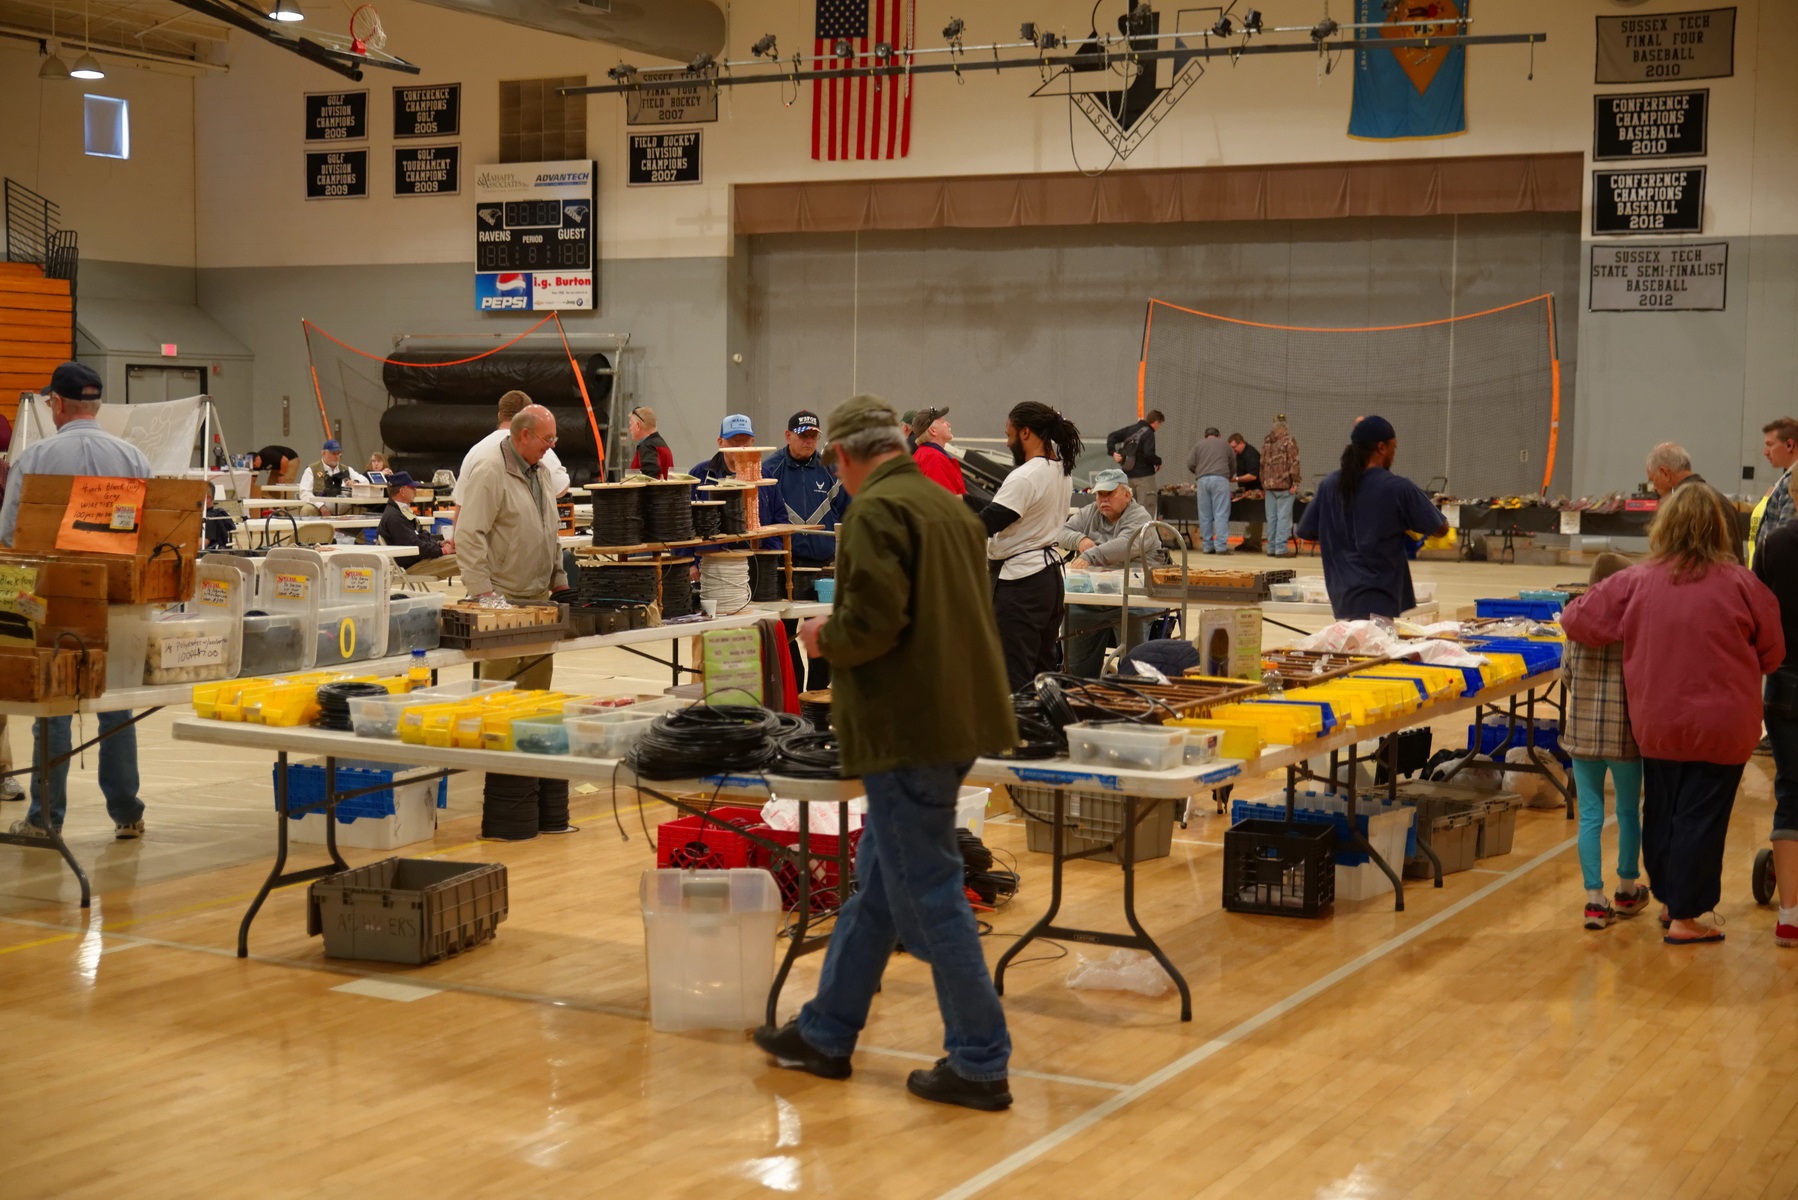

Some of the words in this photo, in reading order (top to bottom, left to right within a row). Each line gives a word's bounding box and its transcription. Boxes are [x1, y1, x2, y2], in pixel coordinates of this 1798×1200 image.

[1621, 18, 1668, 33] SUSSEX
[1679, 15, 1710, 28] TECH
[1625, 33, 1662, 48] FINAL
[1673, 31, 1704, 45] FOUR
[1633, 47, 1695, 63] BASEBALL
[1645, 63, 1681, 78] 2010
[327, 95, 346, 105] GOLF
[403, 88, 450, 101] CONFERENCE
[405, 100, 447, 112] CHAMPIONS
[642, 98, 664, 109] FIELD
[670, 95, 701, 108] HOCKEY
[1612, 95, 1690, 112] CONFERENCE
[321, 105, 352, 117] DIVISION
[416, 111, 436, 122] GOLF
[658, 109, 684, 120] 2007
[316, 116, 355, 128] CHAMPIONS
[1615, 110, 1685, 127] CHAMPIONS
[324, 127, 347, 139] 2005
[414, 122, 438, 133] 2005
[1618, 124, 1681, 141] BASEBALL
[634, 136, 657, 148] FIELD
[663, 134, 695, 147] HOCKEY
[1631, 140, 1667, 154] 2010
[327, 153, 346, 164] GOLF
[417, 149, 436, 160] GOLF
[646, 146, 683, 159] DIVISION
[321, 163, 352, 175] DIVISION
[402, 159, 451, 171] TOURNAMENT
[641, 158, 688, 171] CHAMPIONS
[316, 174, 356, 185] CHAMPIONS
[405, 170, 447, 182] CHAMPIONS
[535, 172, 590, 182] ADVANTECH
[651, 170, 677, 182] 2007
[1610, 172, 1687, 189] CONFERENCE
[325, 184, 348, 196] 2009
[414, 181, 439, 192] 2009
[1613, 186, 1683, 202] CHAMPIONS
[1616, 201, 1678, 216] BASEBALL
[1629, 215, 1664, 229] 2012
[478, 230, 511, 242] RAVENS
[522, 234, 543, 244] PERIOD
[557, 228, 586, 240] GUEST
[1614, 250, 1660, 263] SUSSEX
[1670, 249, 1702, 262] TECH
[1593, 264, 1629, 278] STATE
[1637, 262, 1725, 277] SEMI-FINALIST
[533, 276, 552, 289] i.g.
[555, 276, 591, 286] Burton
[1626, 278, 1688, 293] BASEBALL
[481, 296, 528, 309] PEPSI
[1639, 293, 1674, 307] 2012
